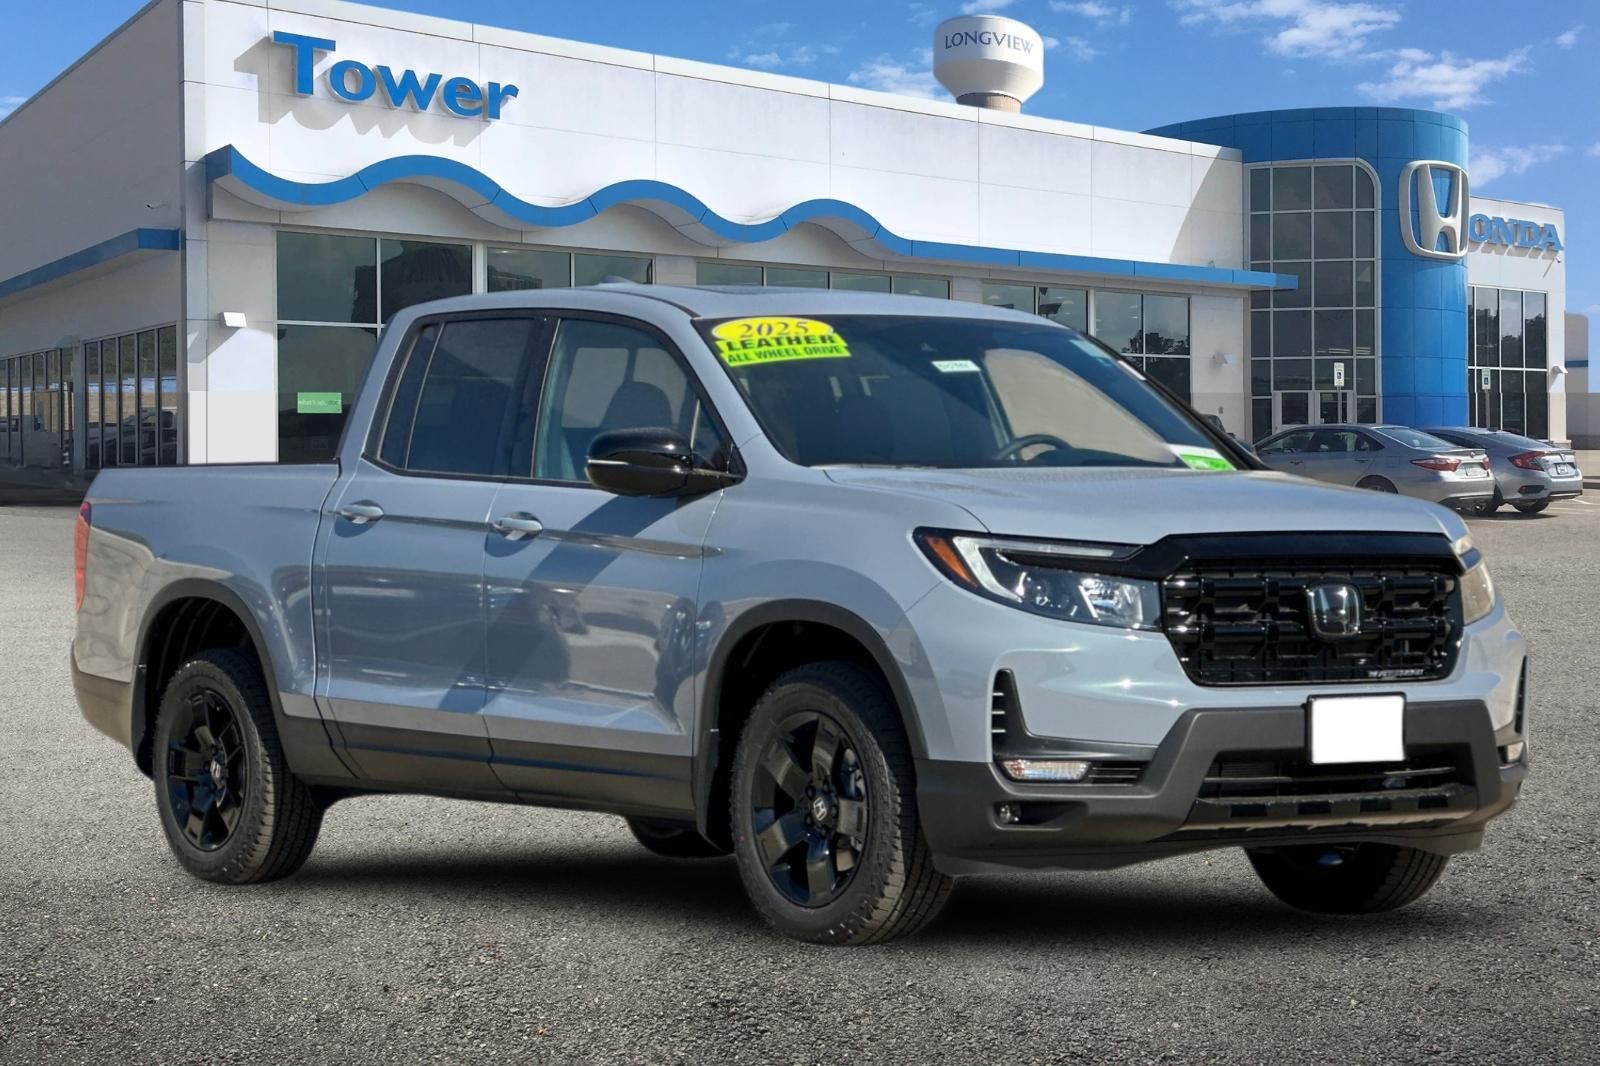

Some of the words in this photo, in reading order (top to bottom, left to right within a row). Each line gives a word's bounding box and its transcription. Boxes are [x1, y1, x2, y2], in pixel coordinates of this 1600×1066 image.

[945, 31, 1034, 55] LONGVIEW
[272, 30, 519, 120] Tower
[1469, 213, 1564, 250] ONDA
[738, 321, 809, 338] 2025
[727, 333, 835, 351] LEATHER
[727, 350, 751, 363] ALL
[754, 347, 800, 359] WHEEL
[803, 344, 844, 355] DRIVE
